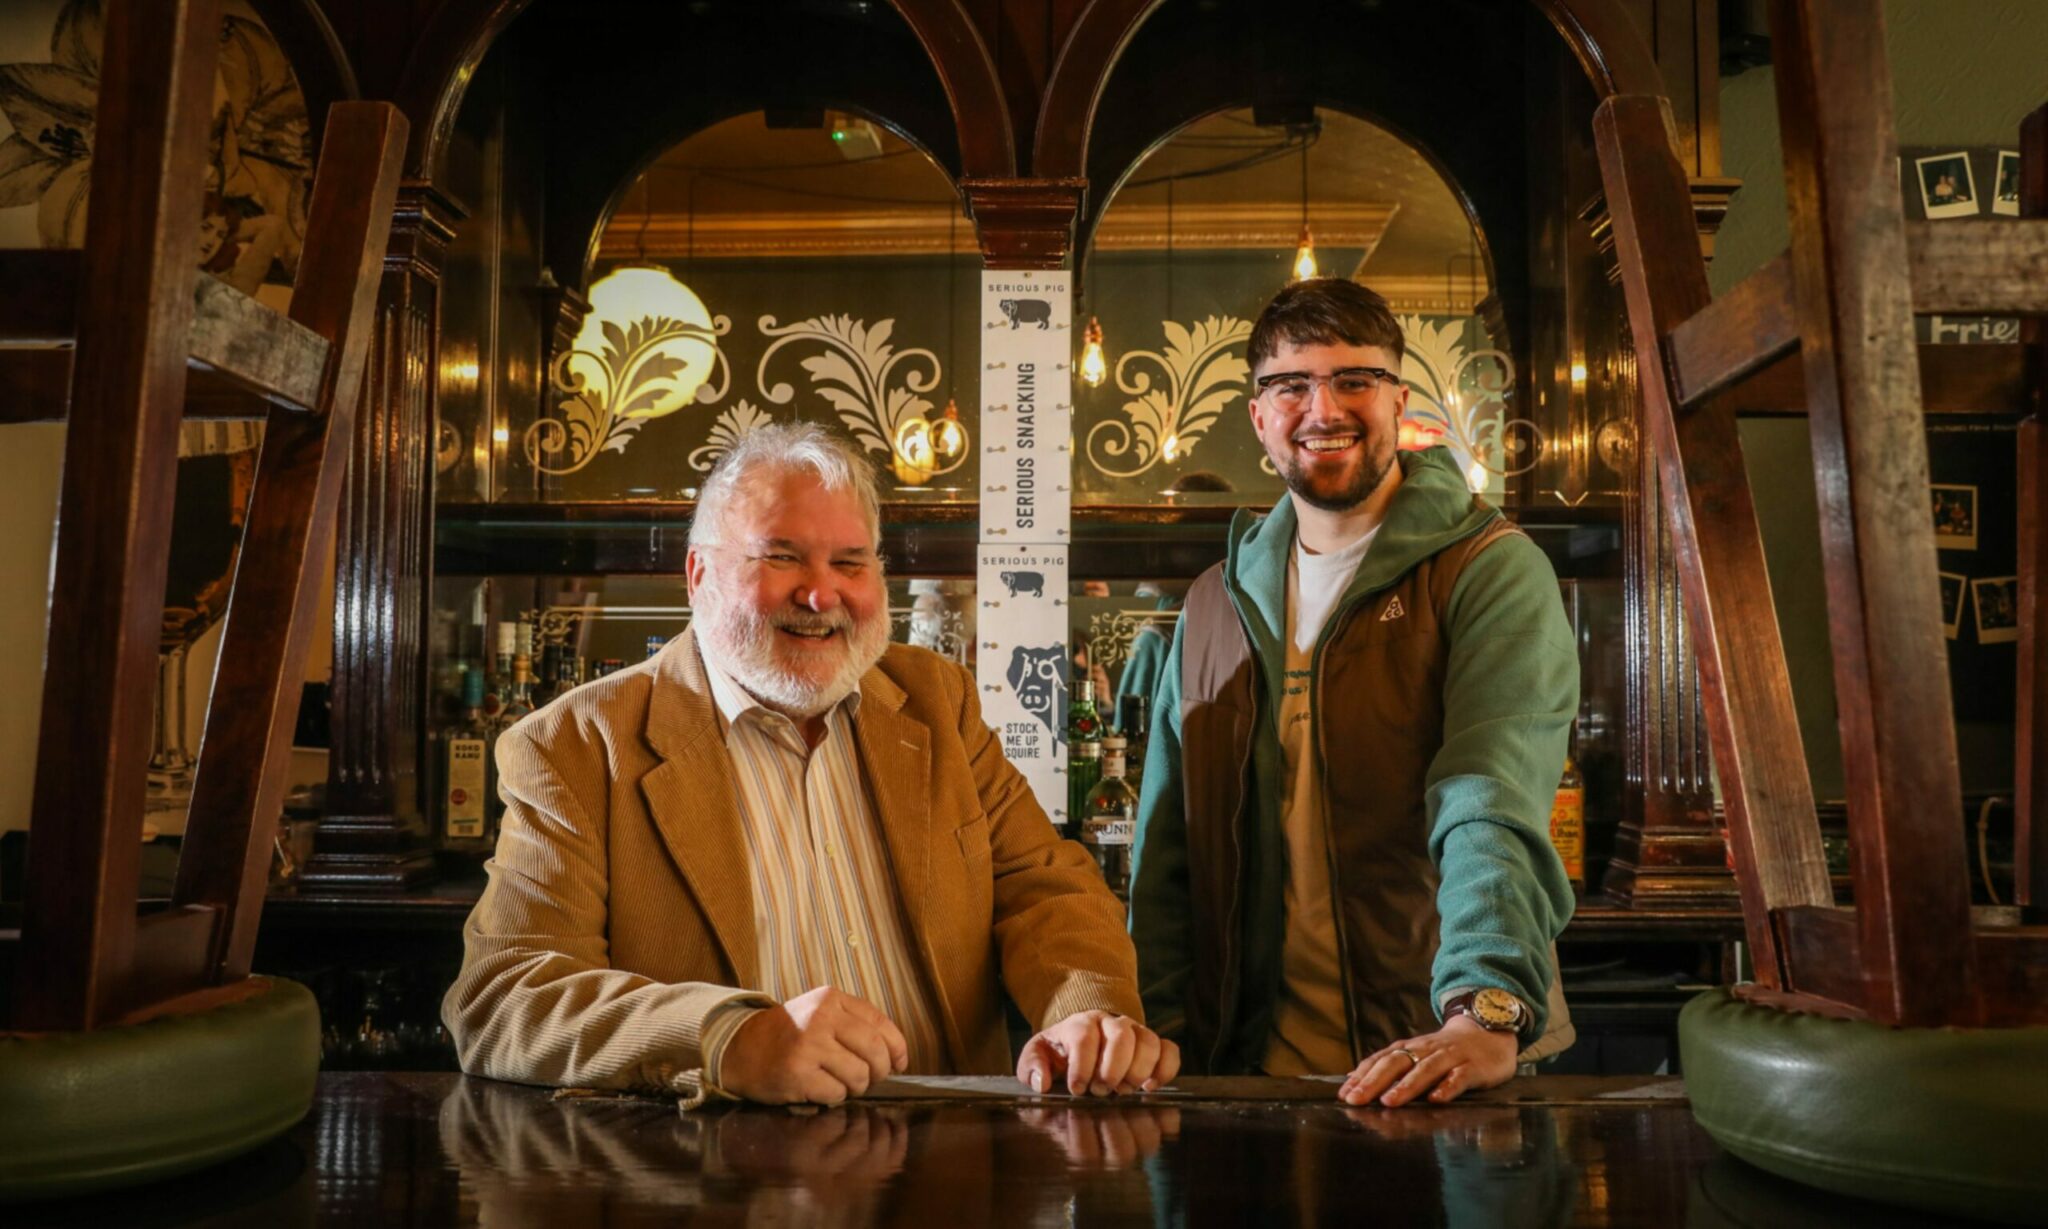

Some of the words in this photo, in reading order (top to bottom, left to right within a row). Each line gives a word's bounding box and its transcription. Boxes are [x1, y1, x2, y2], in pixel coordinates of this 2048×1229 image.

[988, 284, 1039, 292] SERIOUS
[1045, 284, 1064, 292] PIG
[1017, 363, 1035, 448] SNACKING
[1017, 457, 1034, 528] SERIOUS
[982, 557, 1037, 565] SERIOUS
[1043, 557, 1064, 565] PIG
[1006, 723, 1039, 734] STOCK
[1006, 735, 1021, 746] ME
[1025, 735, 1039, 746] UP
[1005, 747, 1040, 759] SQUIRE
